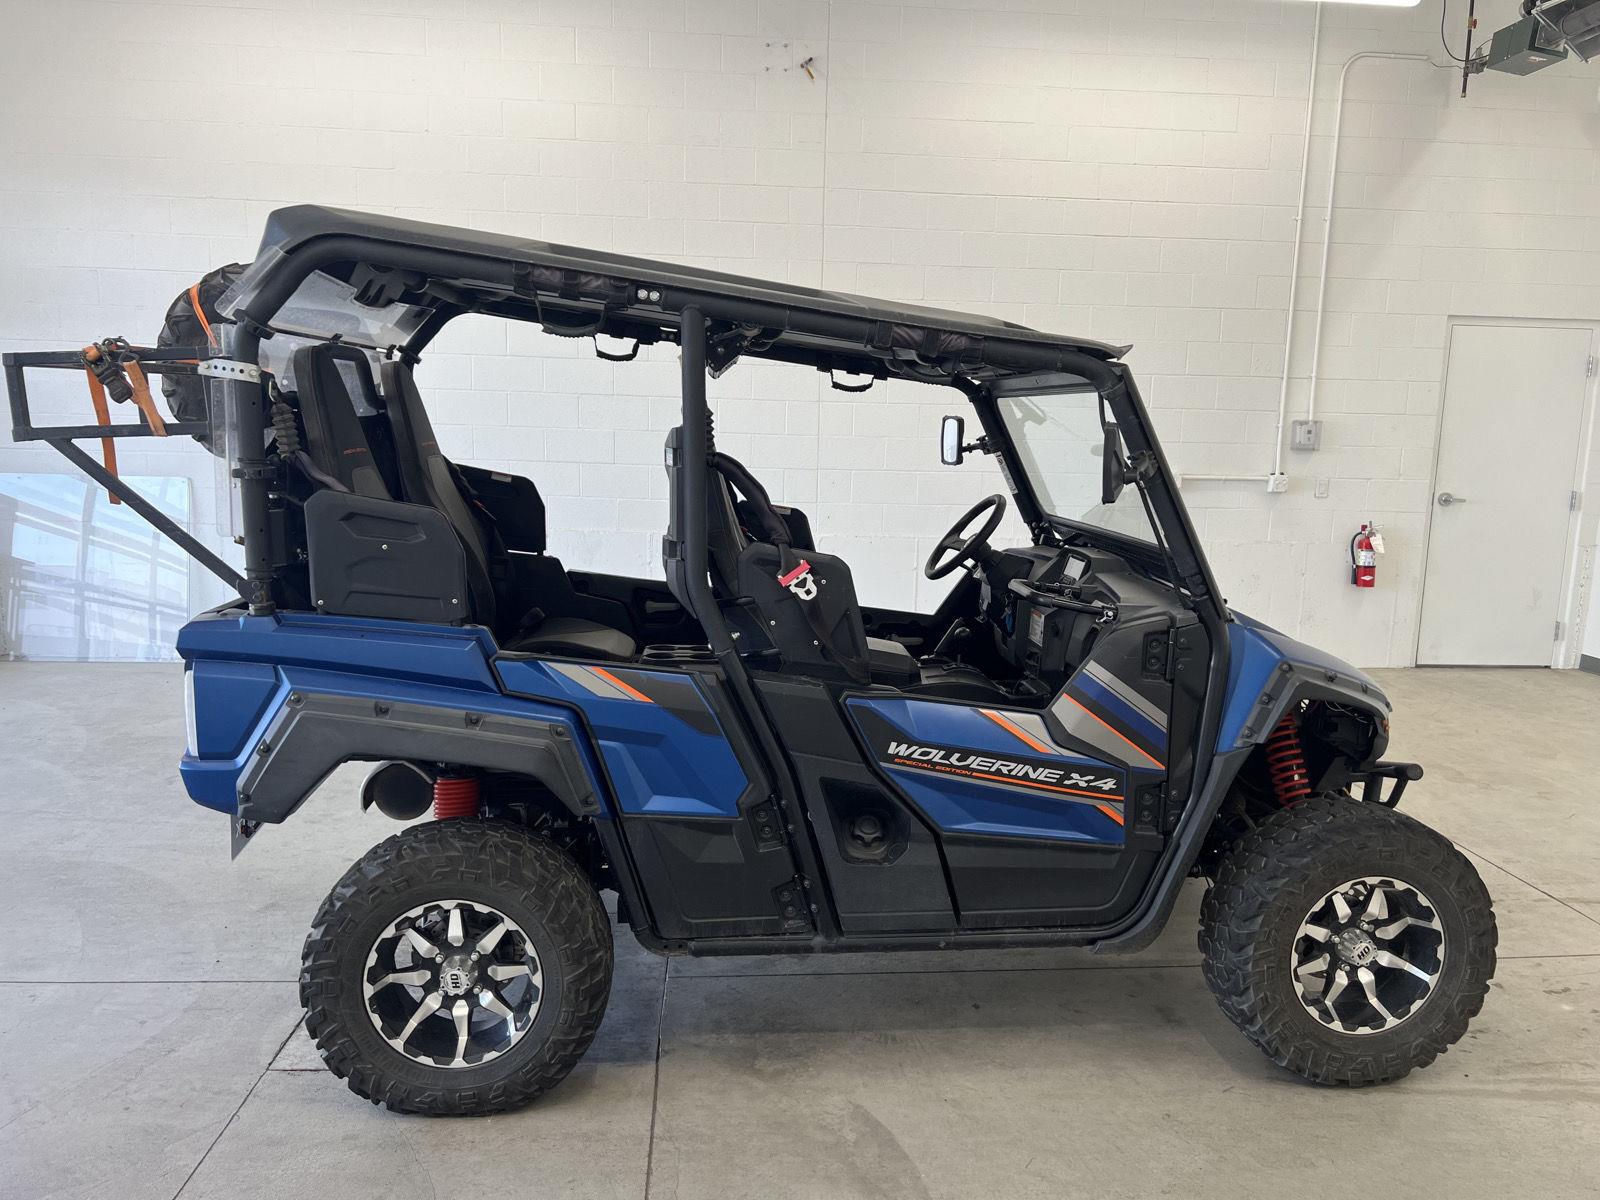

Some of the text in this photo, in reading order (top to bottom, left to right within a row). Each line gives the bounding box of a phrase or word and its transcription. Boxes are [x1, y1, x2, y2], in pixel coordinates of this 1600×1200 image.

[888, 741, 1117, 791] WOLVERINE X4
[894, 758, 972, 776] SPECIAL EDITION
